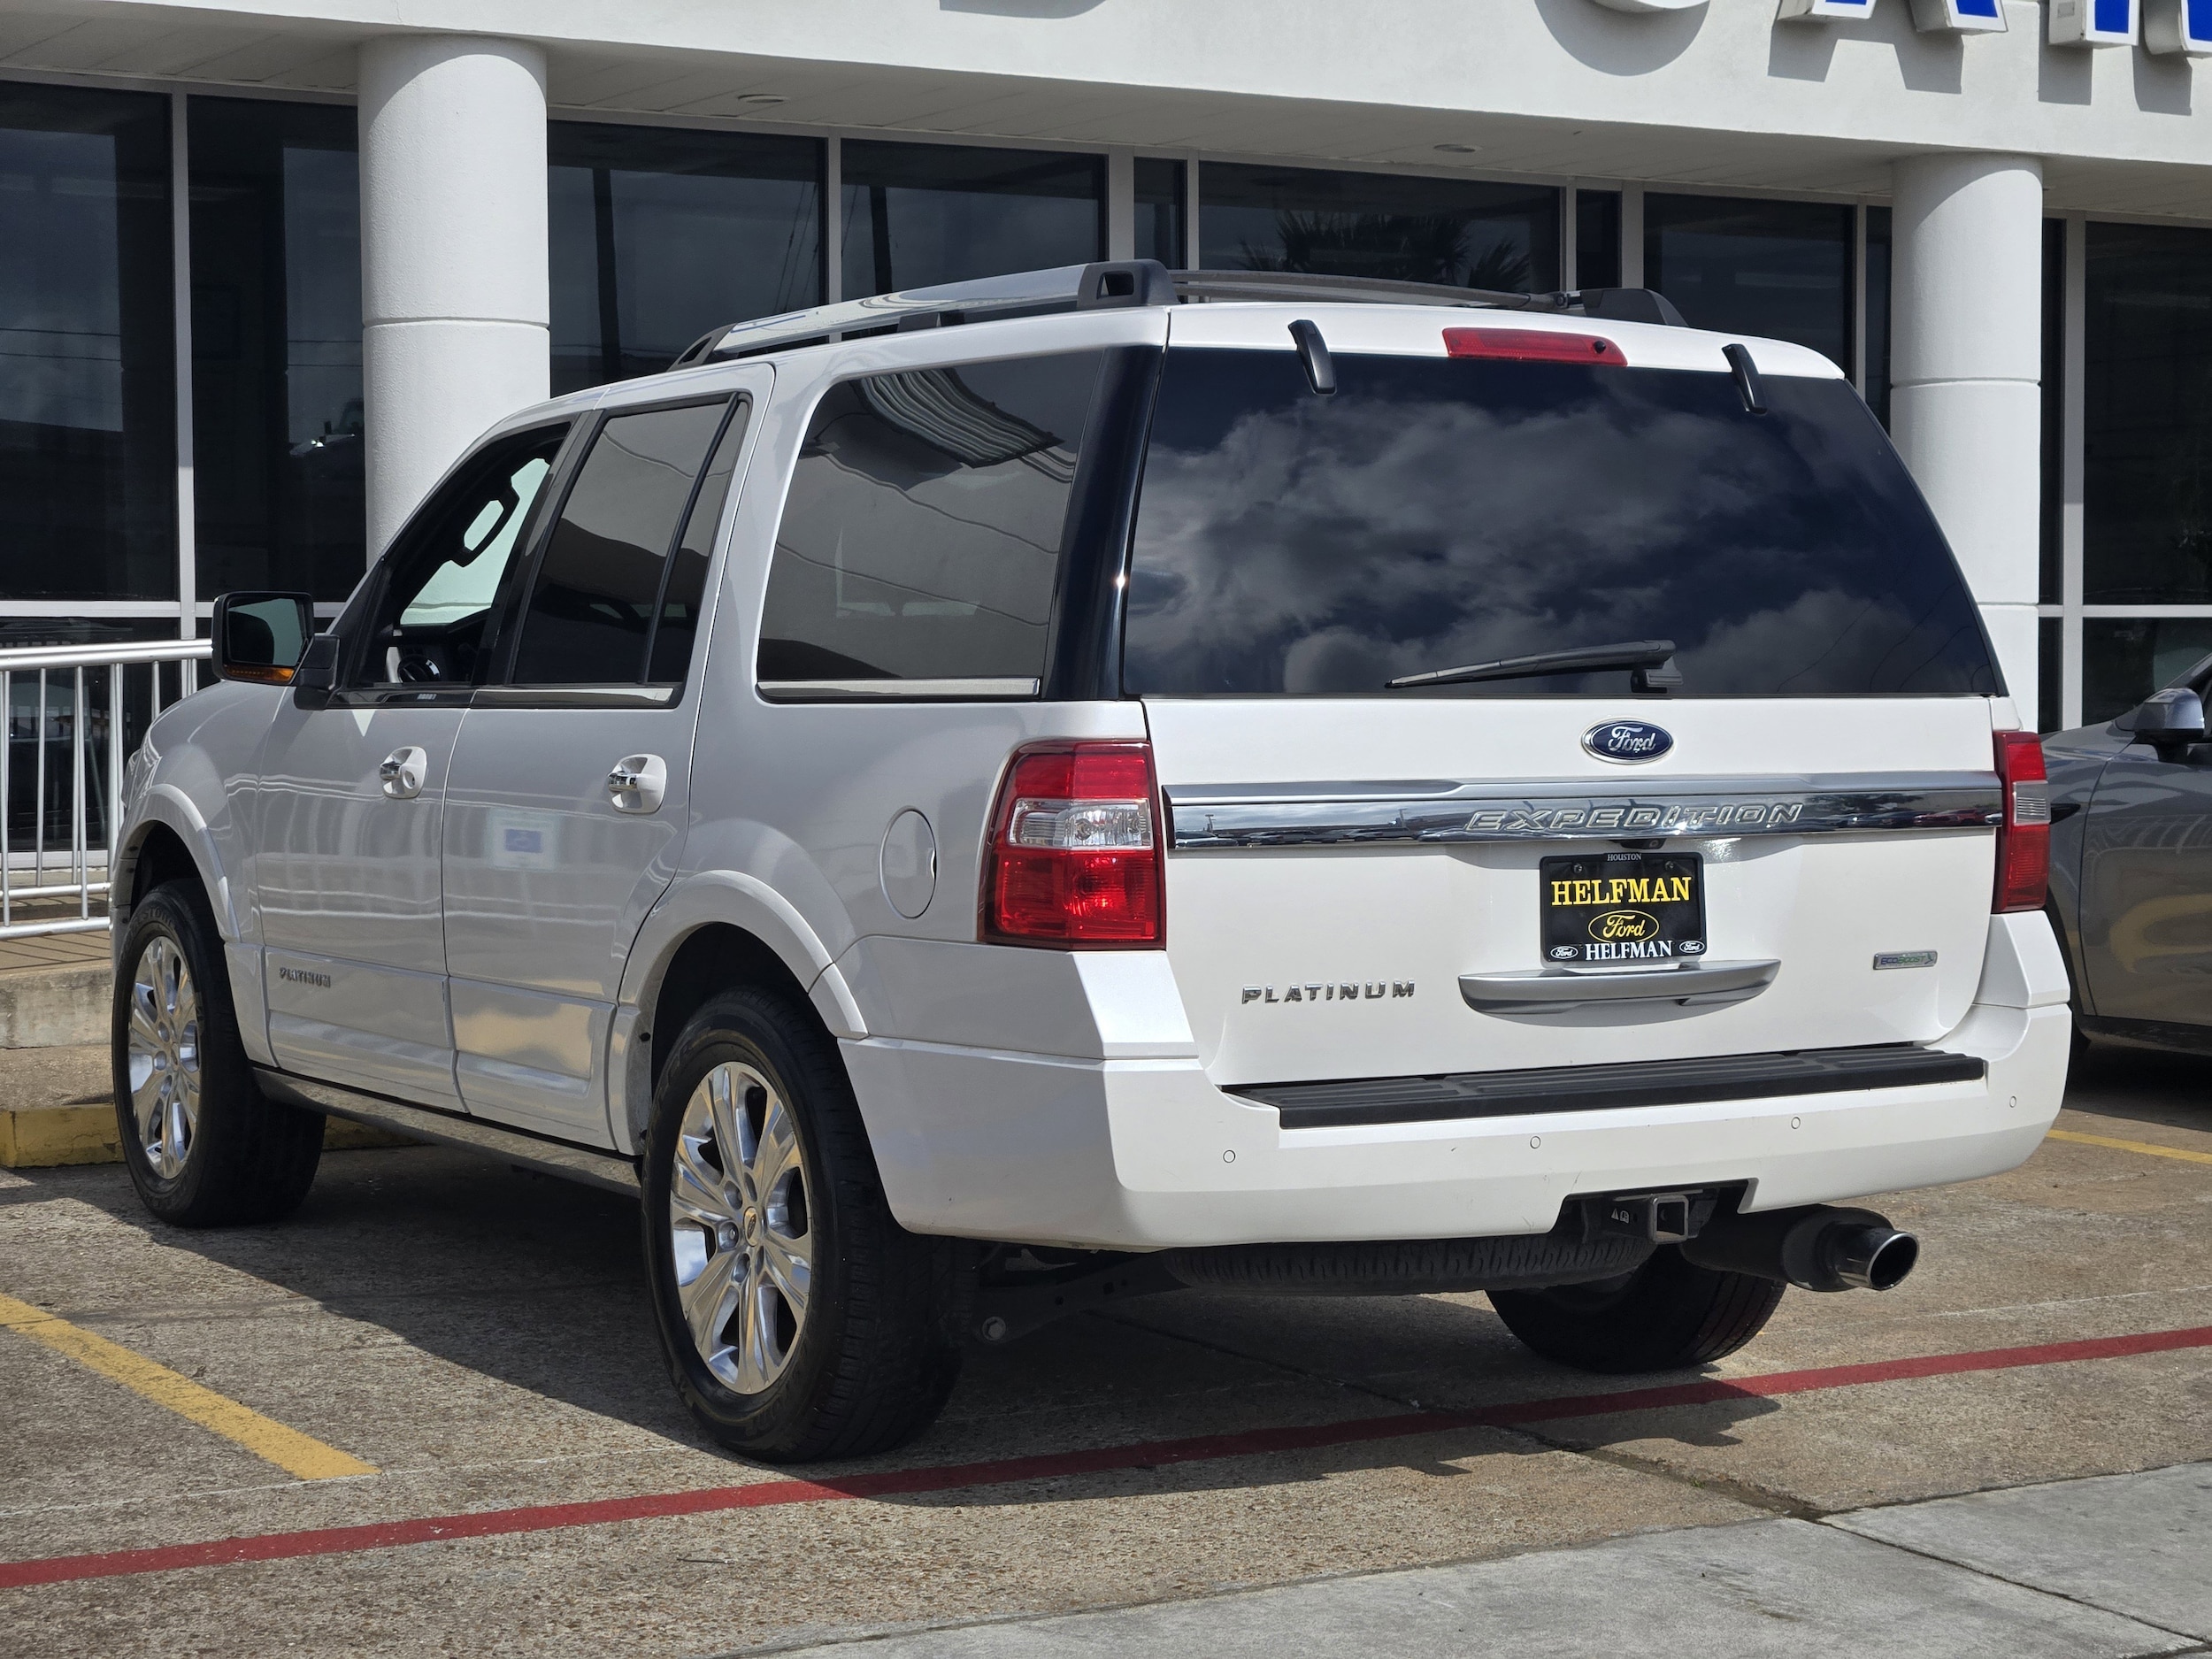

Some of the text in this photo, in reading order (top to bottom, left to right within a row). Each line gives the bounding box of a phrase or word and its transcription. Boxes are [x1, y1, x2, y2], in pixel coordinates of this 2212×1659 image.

[1608, 726, 1656, 752] Ford
[1464, 803, 1805, 832] EXPEDITION
[1607, 853, 1642, 862] HOUSTON
[1551, 876, 1692, 906] HELFMAN
[1602, 913, 1646, 938] Ford
[1555, 940, 1702, 961] Ford HELFMAN Ford
[279, 966, 332, 988] PLATINUM
[1241, 979, 1416, 1005] PLATINUM
